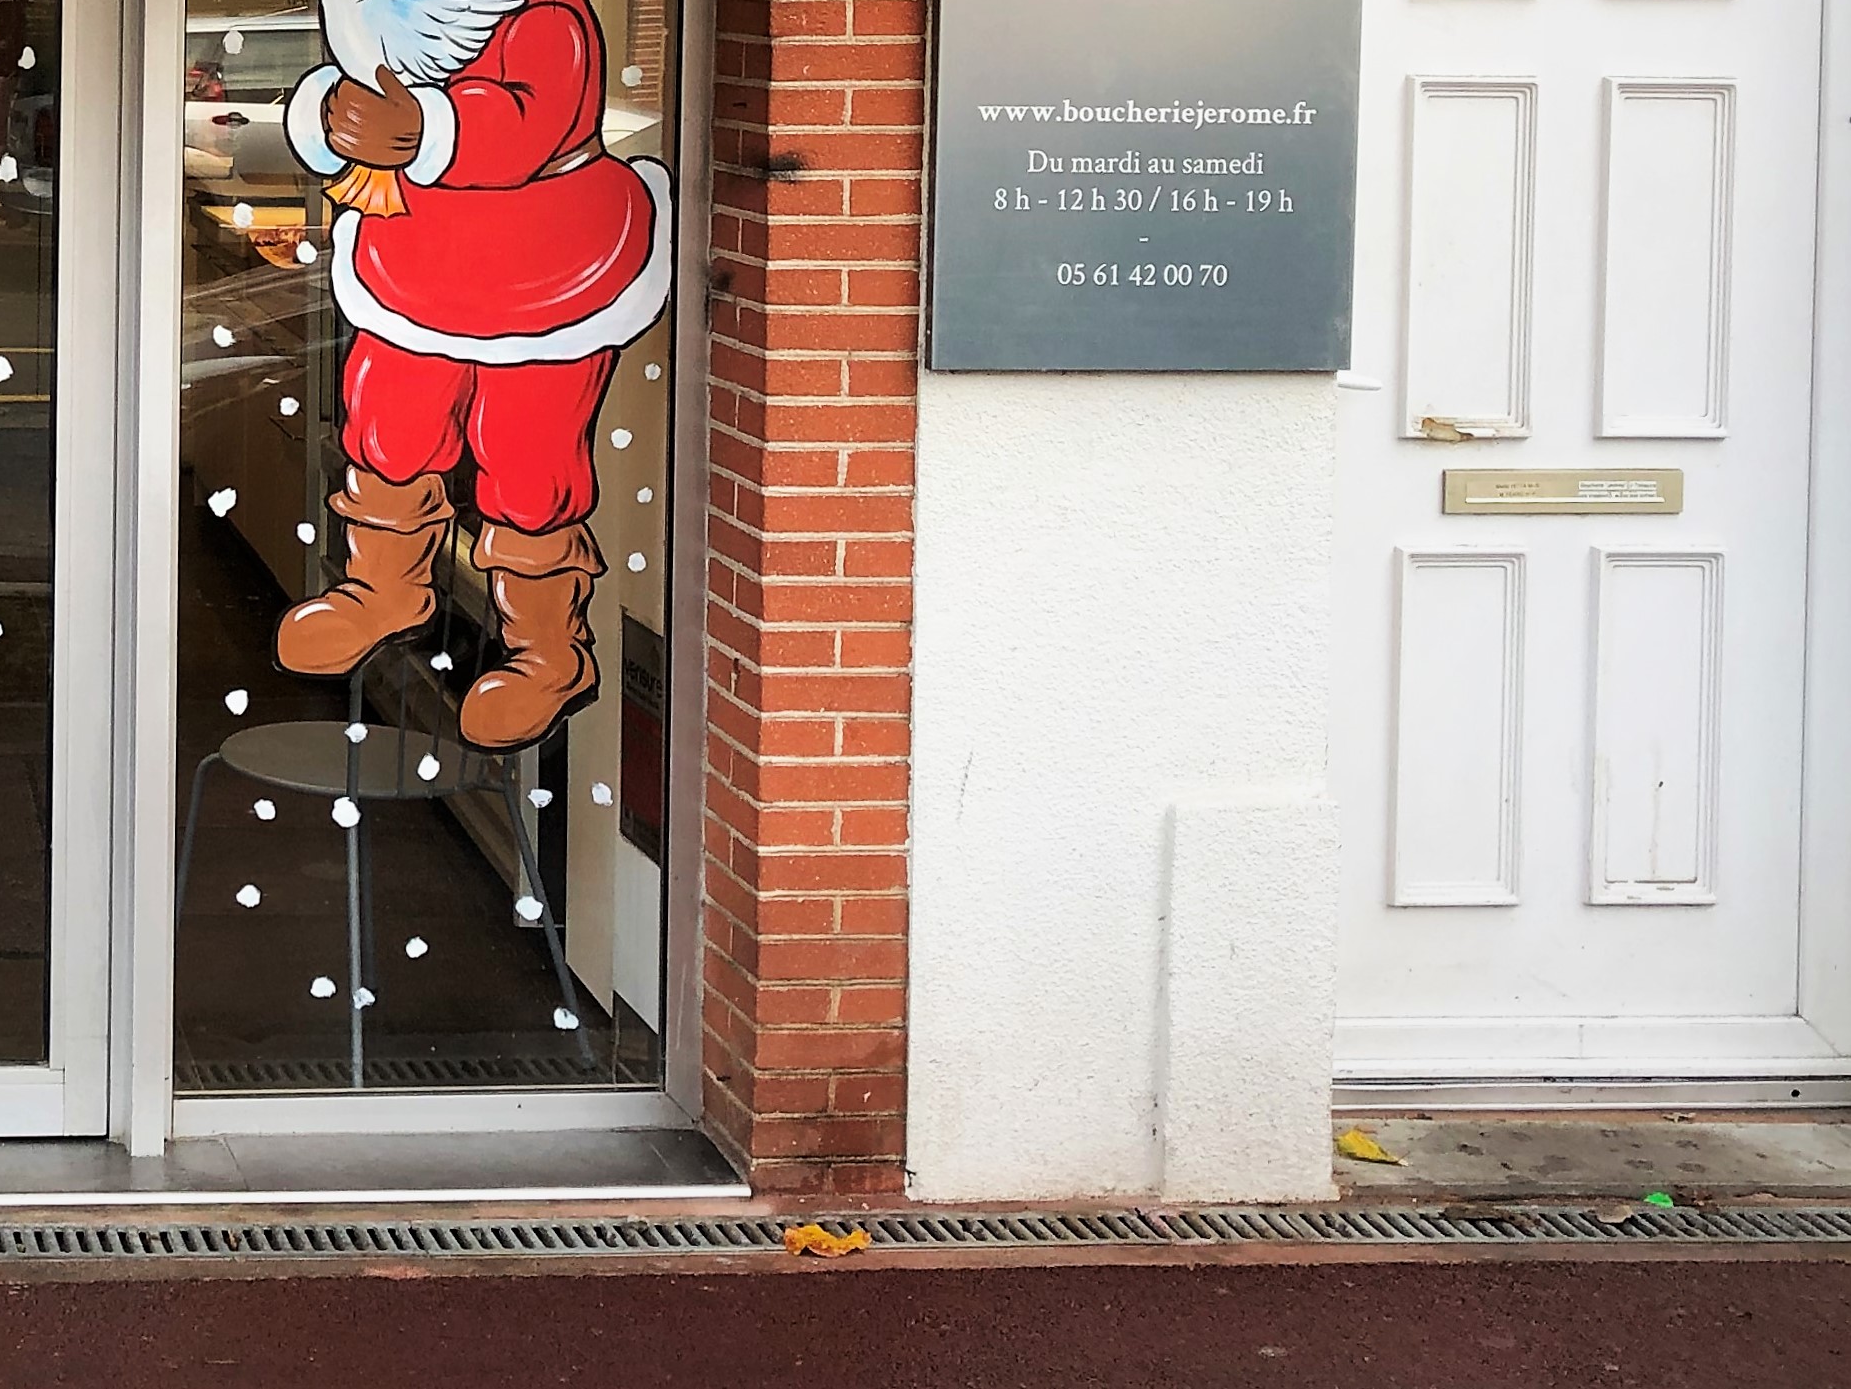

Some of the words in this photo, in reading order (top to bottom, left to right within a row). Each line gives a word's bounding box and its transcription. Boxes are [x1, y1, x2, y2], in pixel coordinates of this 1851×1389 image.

[978, 99, 1318, 131] www.boucheriejerome.fr
[1027, 150, 1065, 174] Du
[1070, 150, 1142, 174] mardi
[1148, 157, 1176, 175] au
[1181, 152, 1265, 176] samedi
[993, 188, 1008, 211] 8
[1014, 187, 1031, 211] h
[1057, 189, 1084, 211] 12
[1090, 188, 1107, 212] h
[1113, 189, 1144, 212] 30
[1148, 185, 1163, 213] /
[1170, 189, 1198, 212] 16
[1203, 189, 1220, 212] h
[1245, 190, 1273, 213] 19
[1278, 189, 1295, 213] h
[1057, 263, 1087, 287] 05
[1092, 263, 1120, 287] 61
[1128, 264, 1157, 287] 42
[1163, 264, 1193, 287] 00
[1199, 264, 1229, 288] 70
